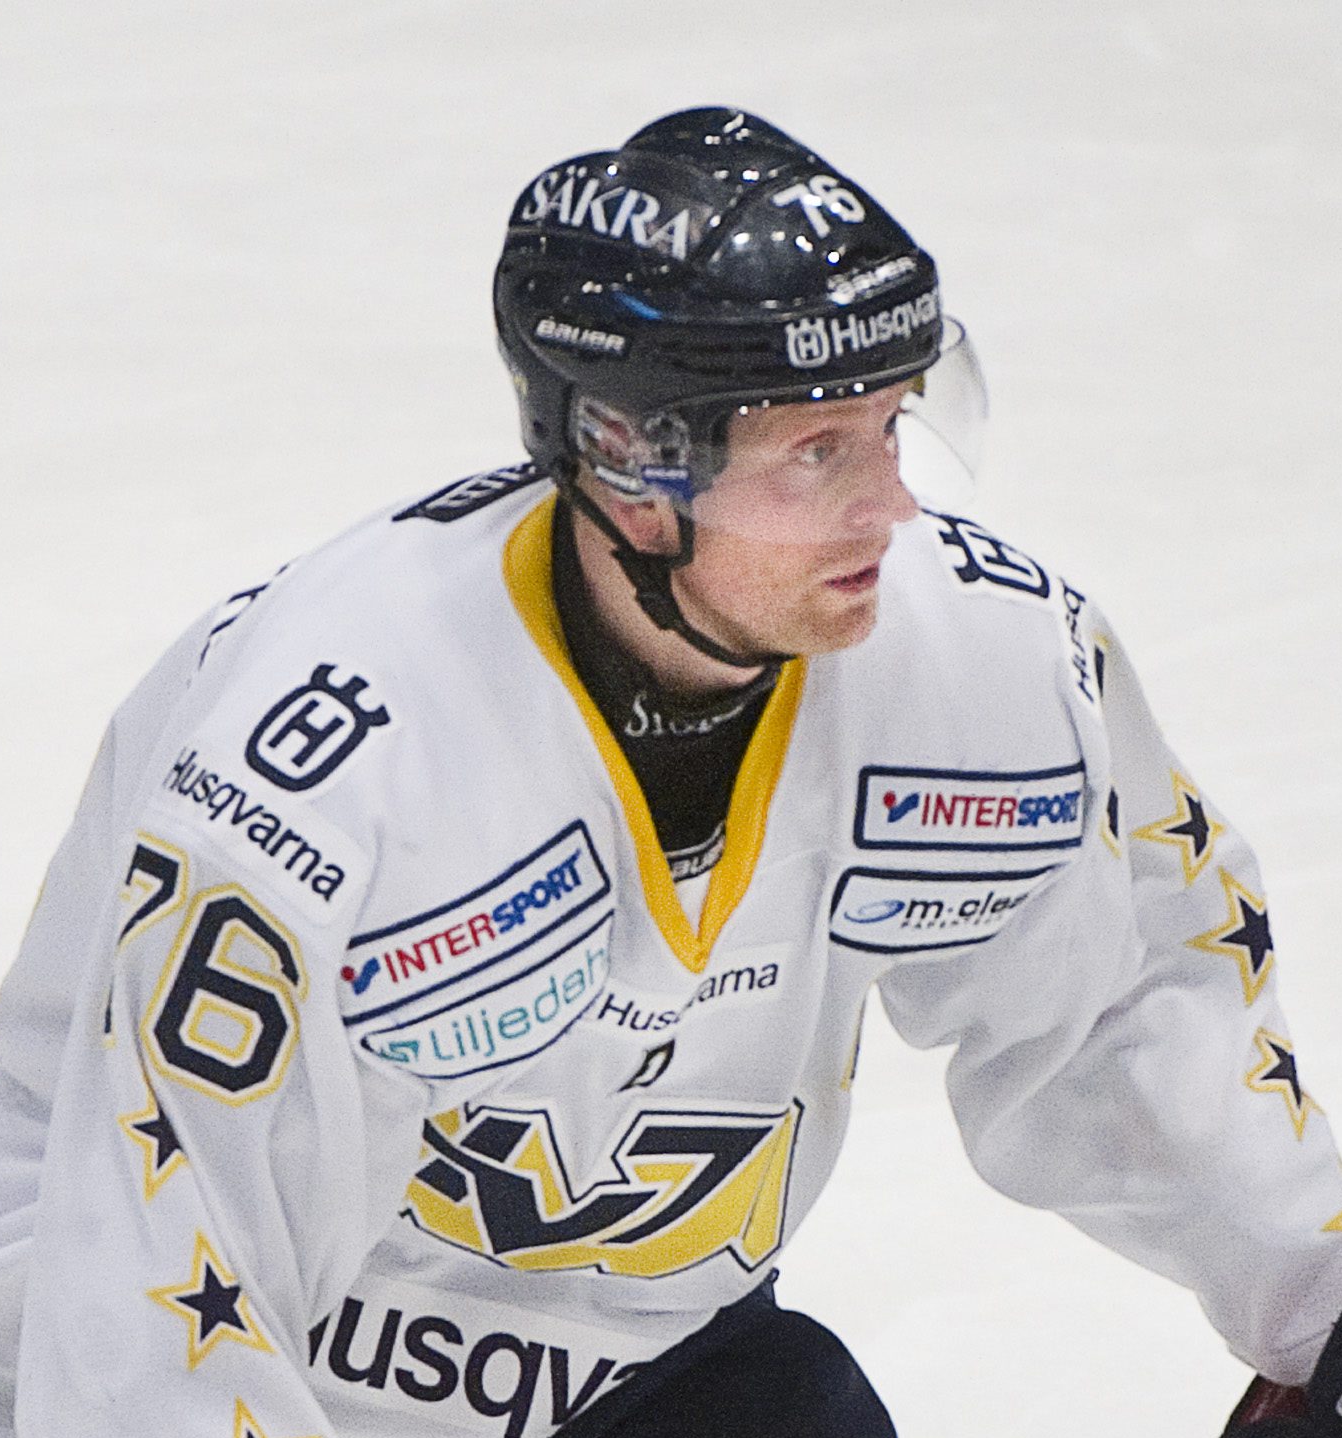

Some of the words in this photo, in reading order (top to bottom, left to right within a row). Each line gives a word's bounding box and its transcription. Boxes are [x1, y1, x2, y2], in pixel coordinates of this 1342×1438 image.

[522, 165, 691, 260] SÄKRA
[774, 174, 866, 237] 76
[164, 746, 346, 903] Husqvarna
[921, 791, 1081, 828] INTERSPORT
[384, 849, 584, 983] INTERSPORT
